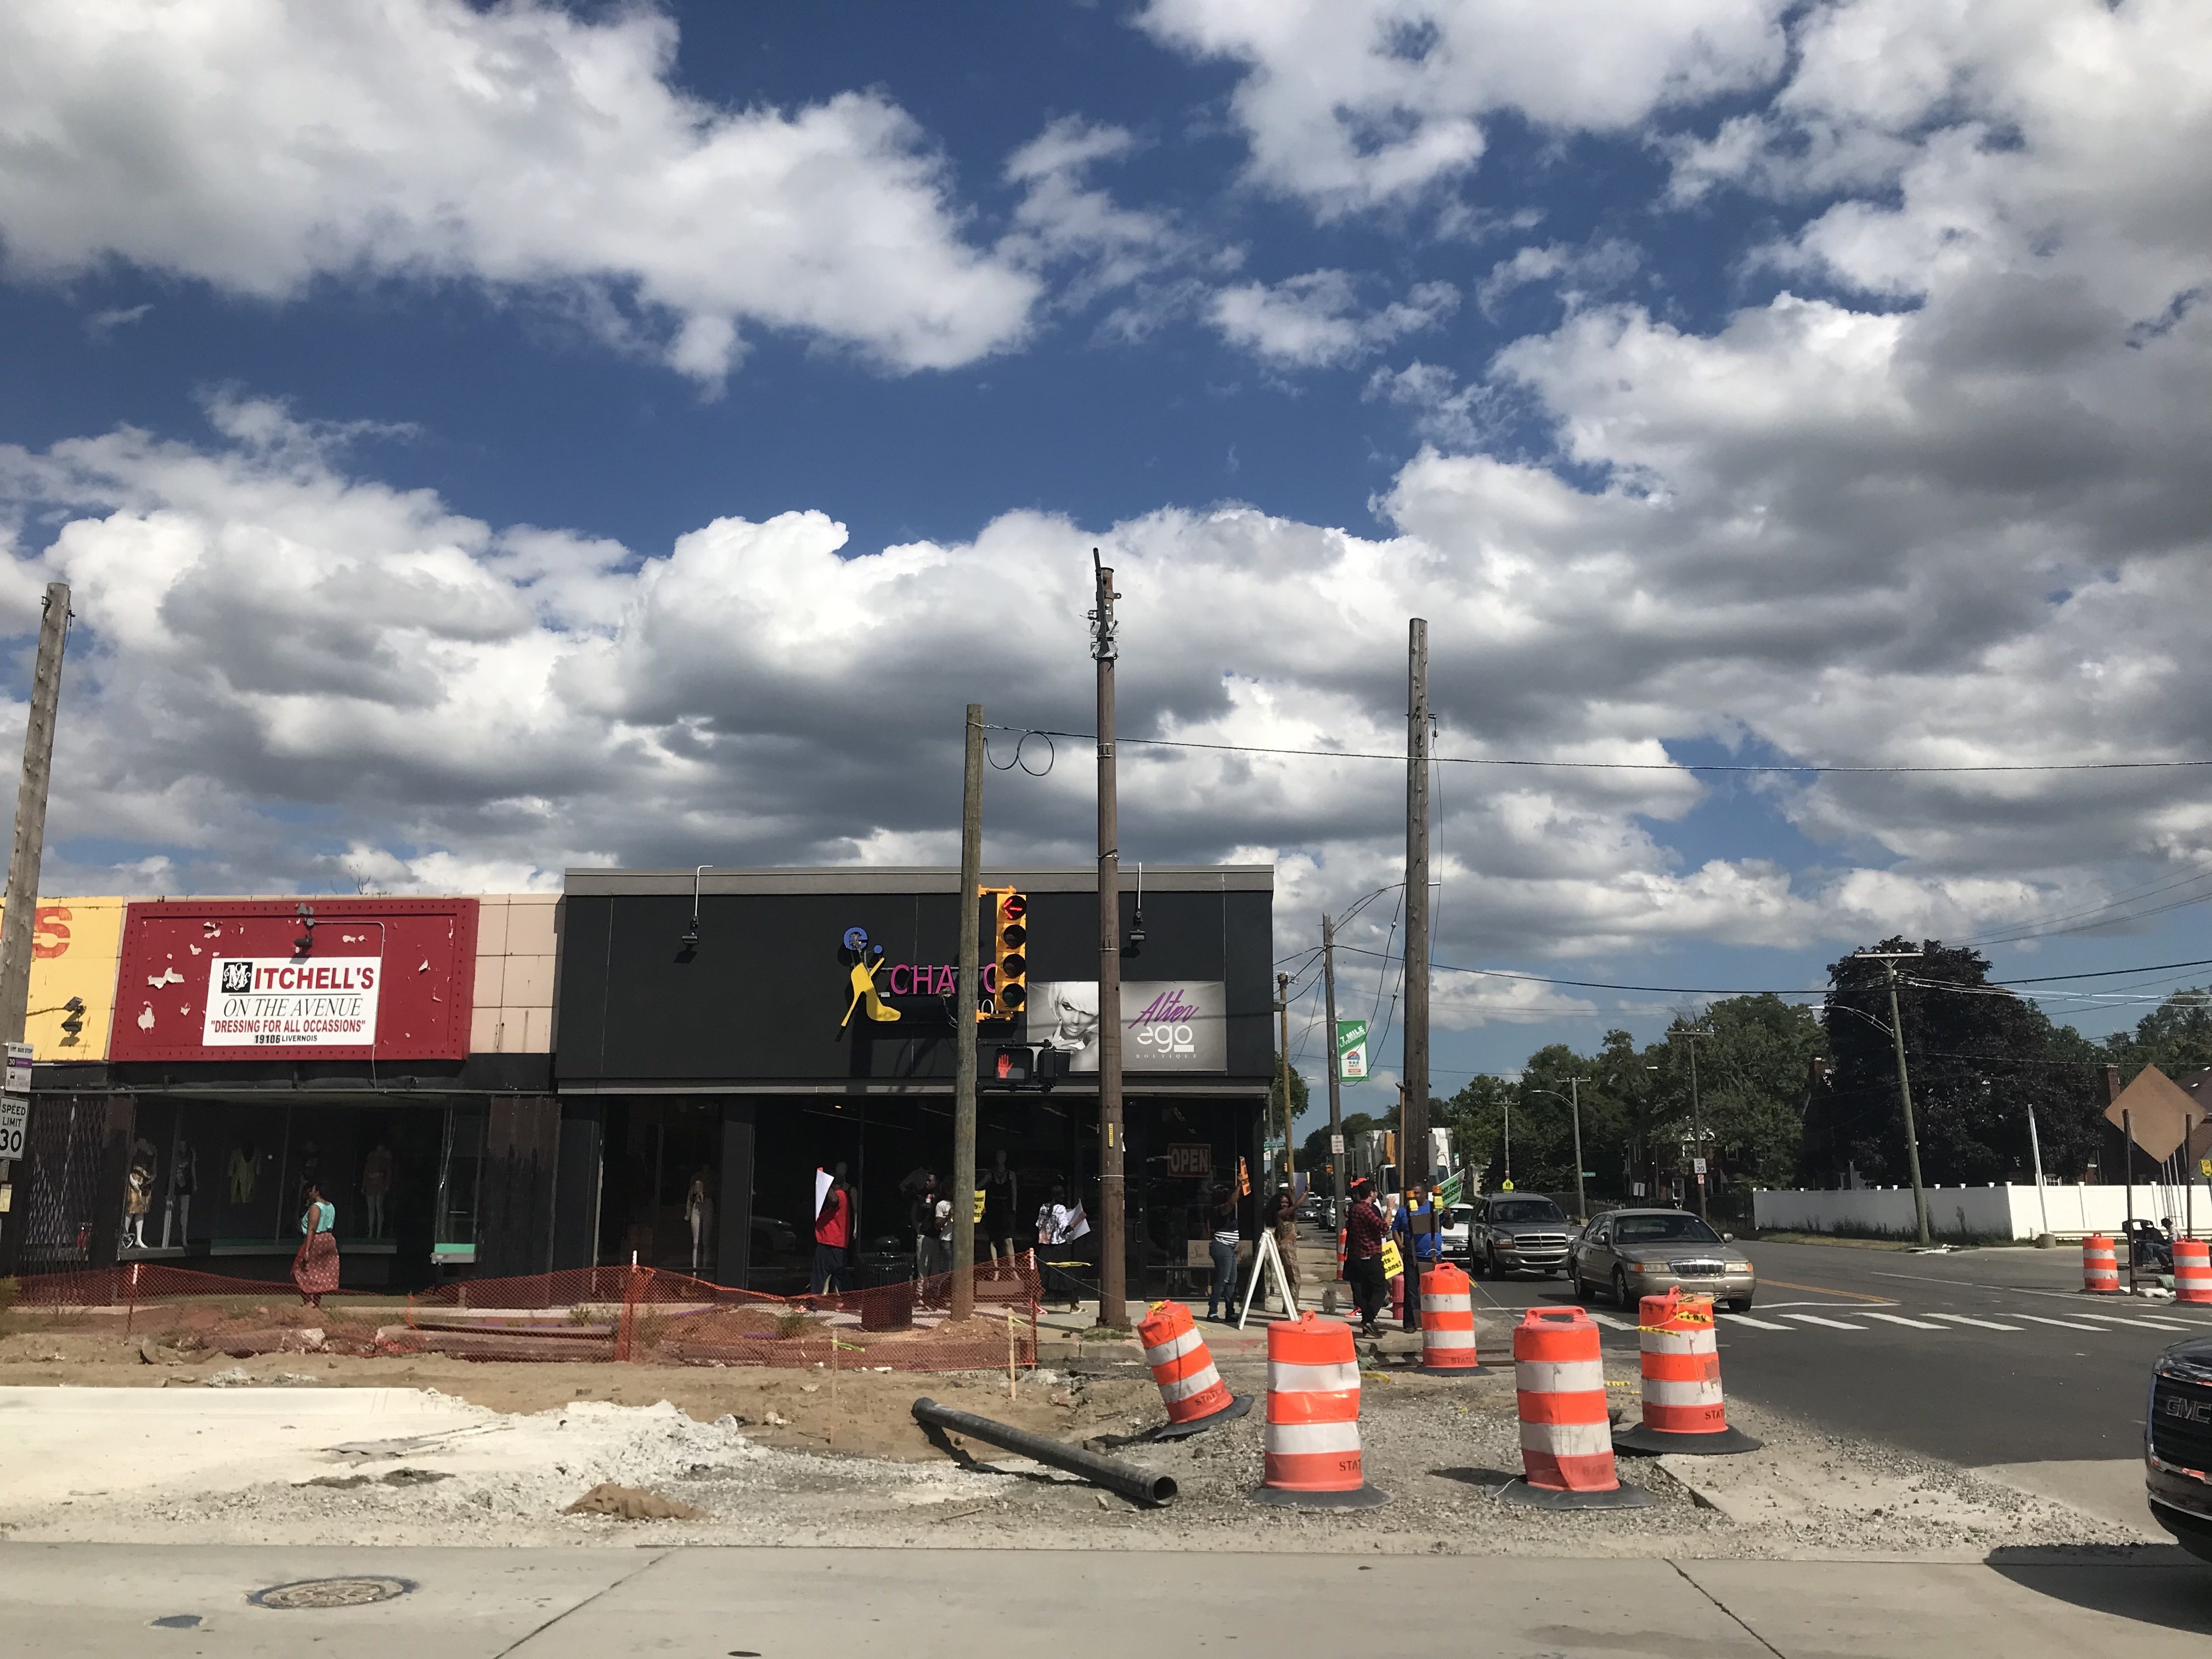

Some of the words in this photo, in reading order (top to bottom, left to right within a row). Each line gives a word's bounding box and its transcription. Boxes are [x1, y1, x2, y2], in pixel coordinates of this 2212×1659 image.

[224, 998, 251, 1017] ON
[254, 998, 290, 1017] THE
[290, 997, 363, 1017] AVENUE
[1127, 989, 1200, 1030] Alter
[211, 1019, 261, 1033] "DRESSING
[263, 1020, 281, 1032] FOR
[284, 1020, 301, 1032] ALL
[303, 1019, 366, 1032] OCCASSIONS"
[1345, 1025, 1364, 1040] MILE
[255, 1034, 281, 1044] 19106
[1137, 1025, 1193, 1053] ego
[1339, 1031, 1365, 1047] LIVERNOIS
[1, 1104, 26, 1116] SPEED
[2, 1116, 22, 1128] LIMIT
[0, 1128, 22, 1152] 30
[1171, 1148, 1209, 1172] OPEN
[2166, 1395, 2212, 1425] GMC
